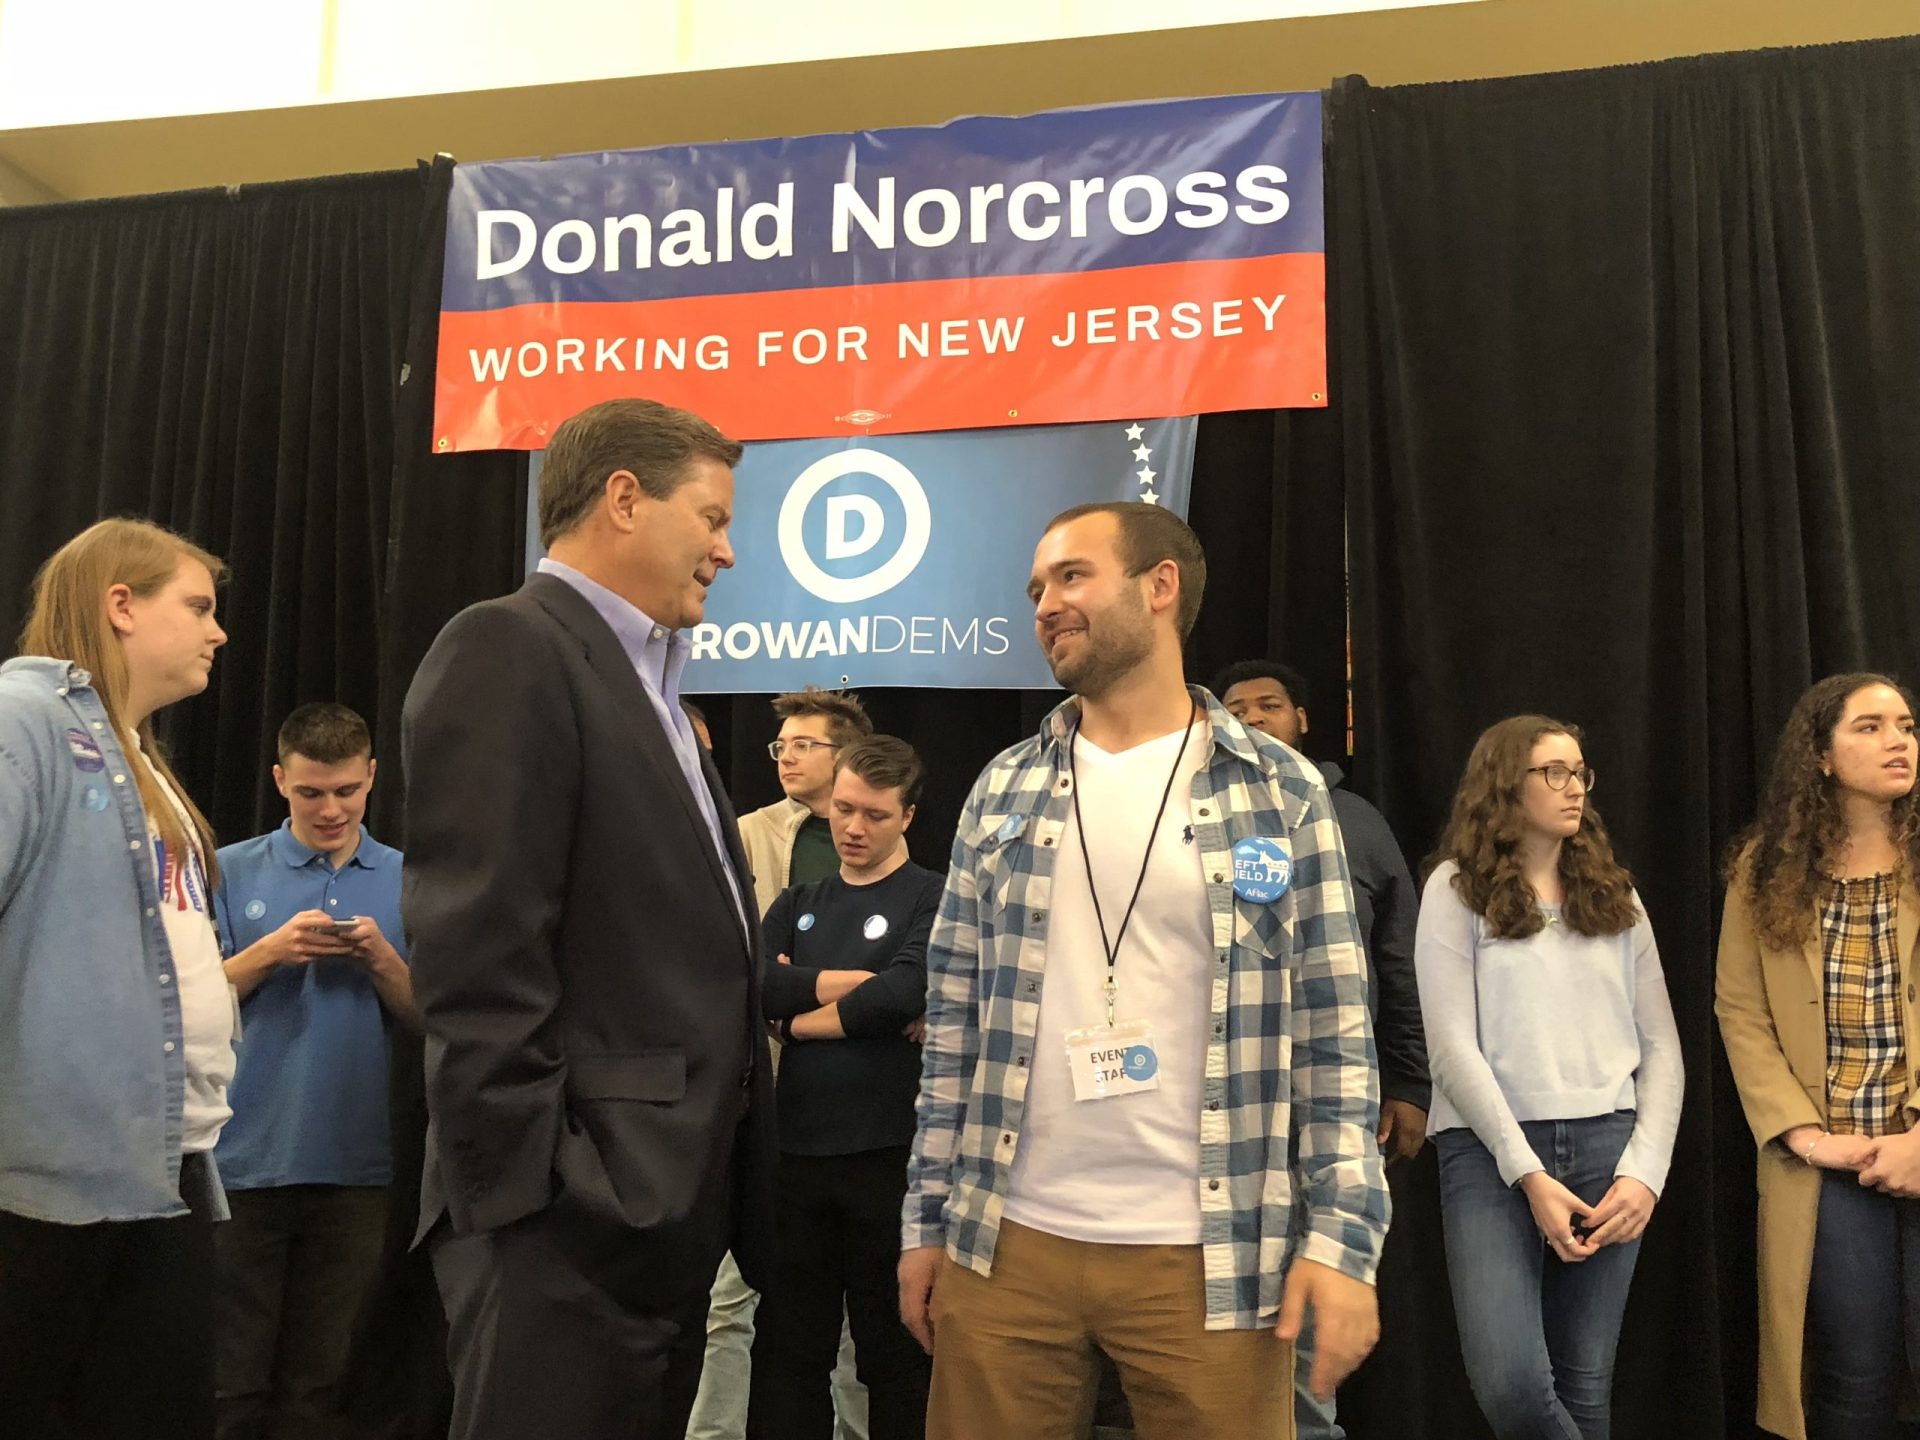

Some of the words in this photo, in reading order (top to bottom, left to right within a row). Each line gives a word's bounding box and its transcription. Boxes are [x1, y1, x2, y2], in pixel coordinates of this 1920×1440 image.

[476, 181, 795, 280] Donald
[831, 164, 1291, 253] Norcross
[468, 334, 730, 383] WORKING
[756, 326, 869, 367] FOR
[899, 316, 1026, 359] NEW
[1051, 294, 1288, 348] JERSEY
[825, 493, 885, 560] D
[1234, 859, 1259, 871] EFT
[1234, 869, 1263, 881] IELD
